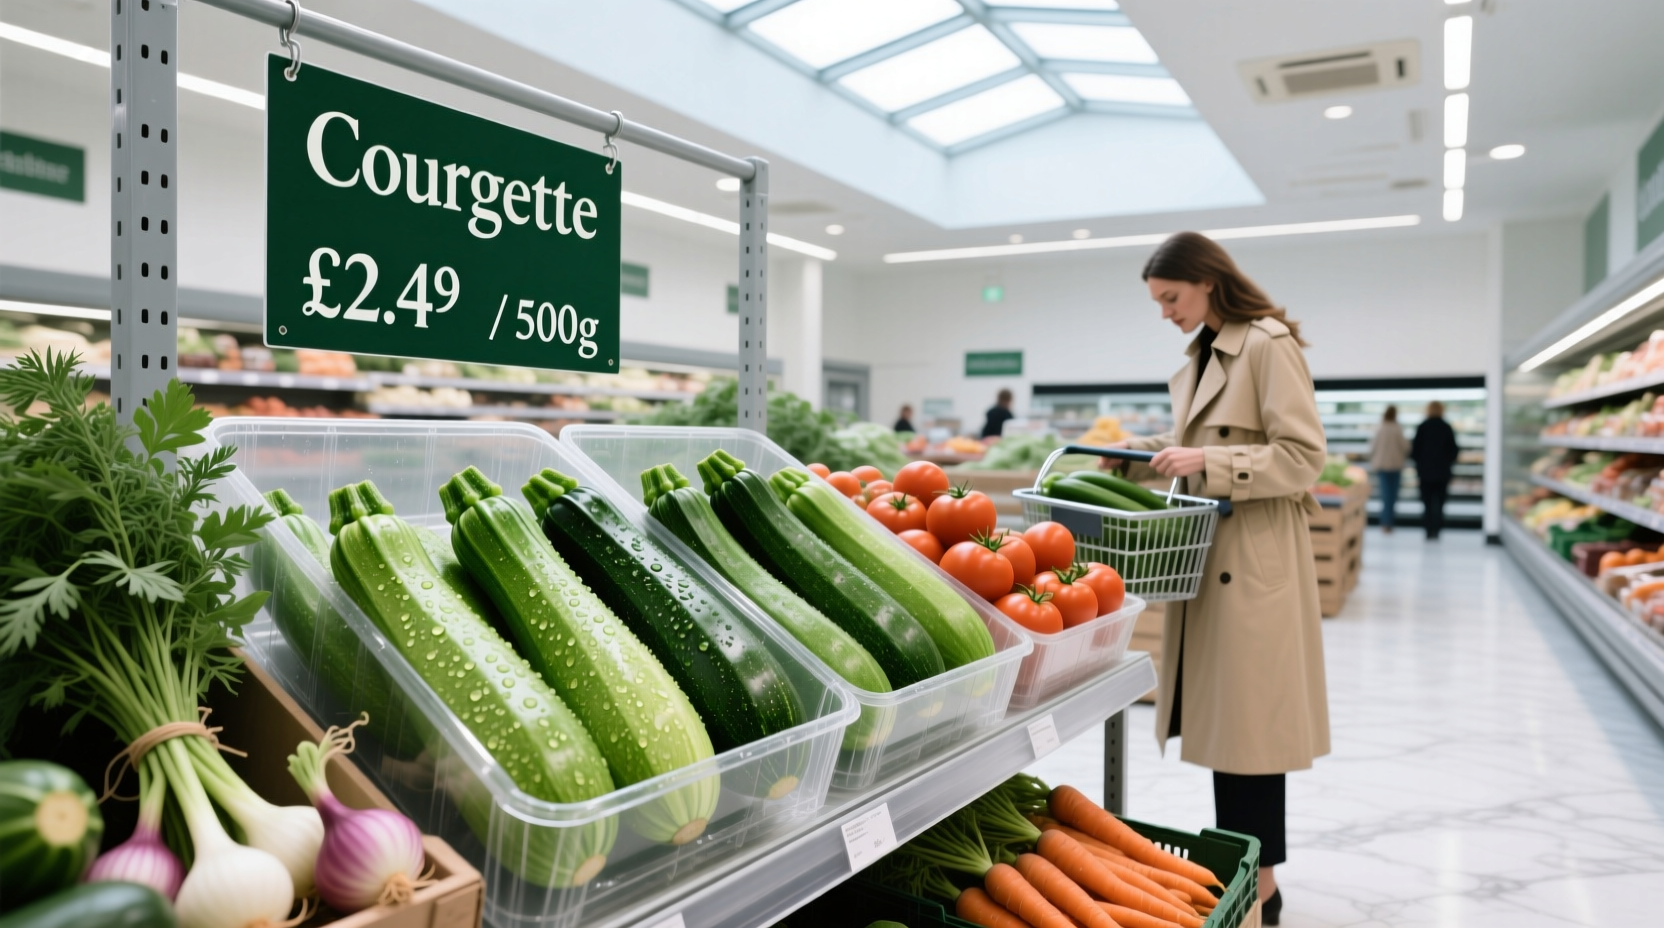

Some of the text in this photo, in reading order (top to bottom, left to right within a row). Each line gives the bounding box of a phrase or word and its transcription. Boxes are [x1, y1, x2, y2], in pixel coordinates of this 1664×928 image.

[306, 111, 598, 240] Courgette
[302, 246, 460, 329] £2.49
[515, 299, 600, 359] 500g
